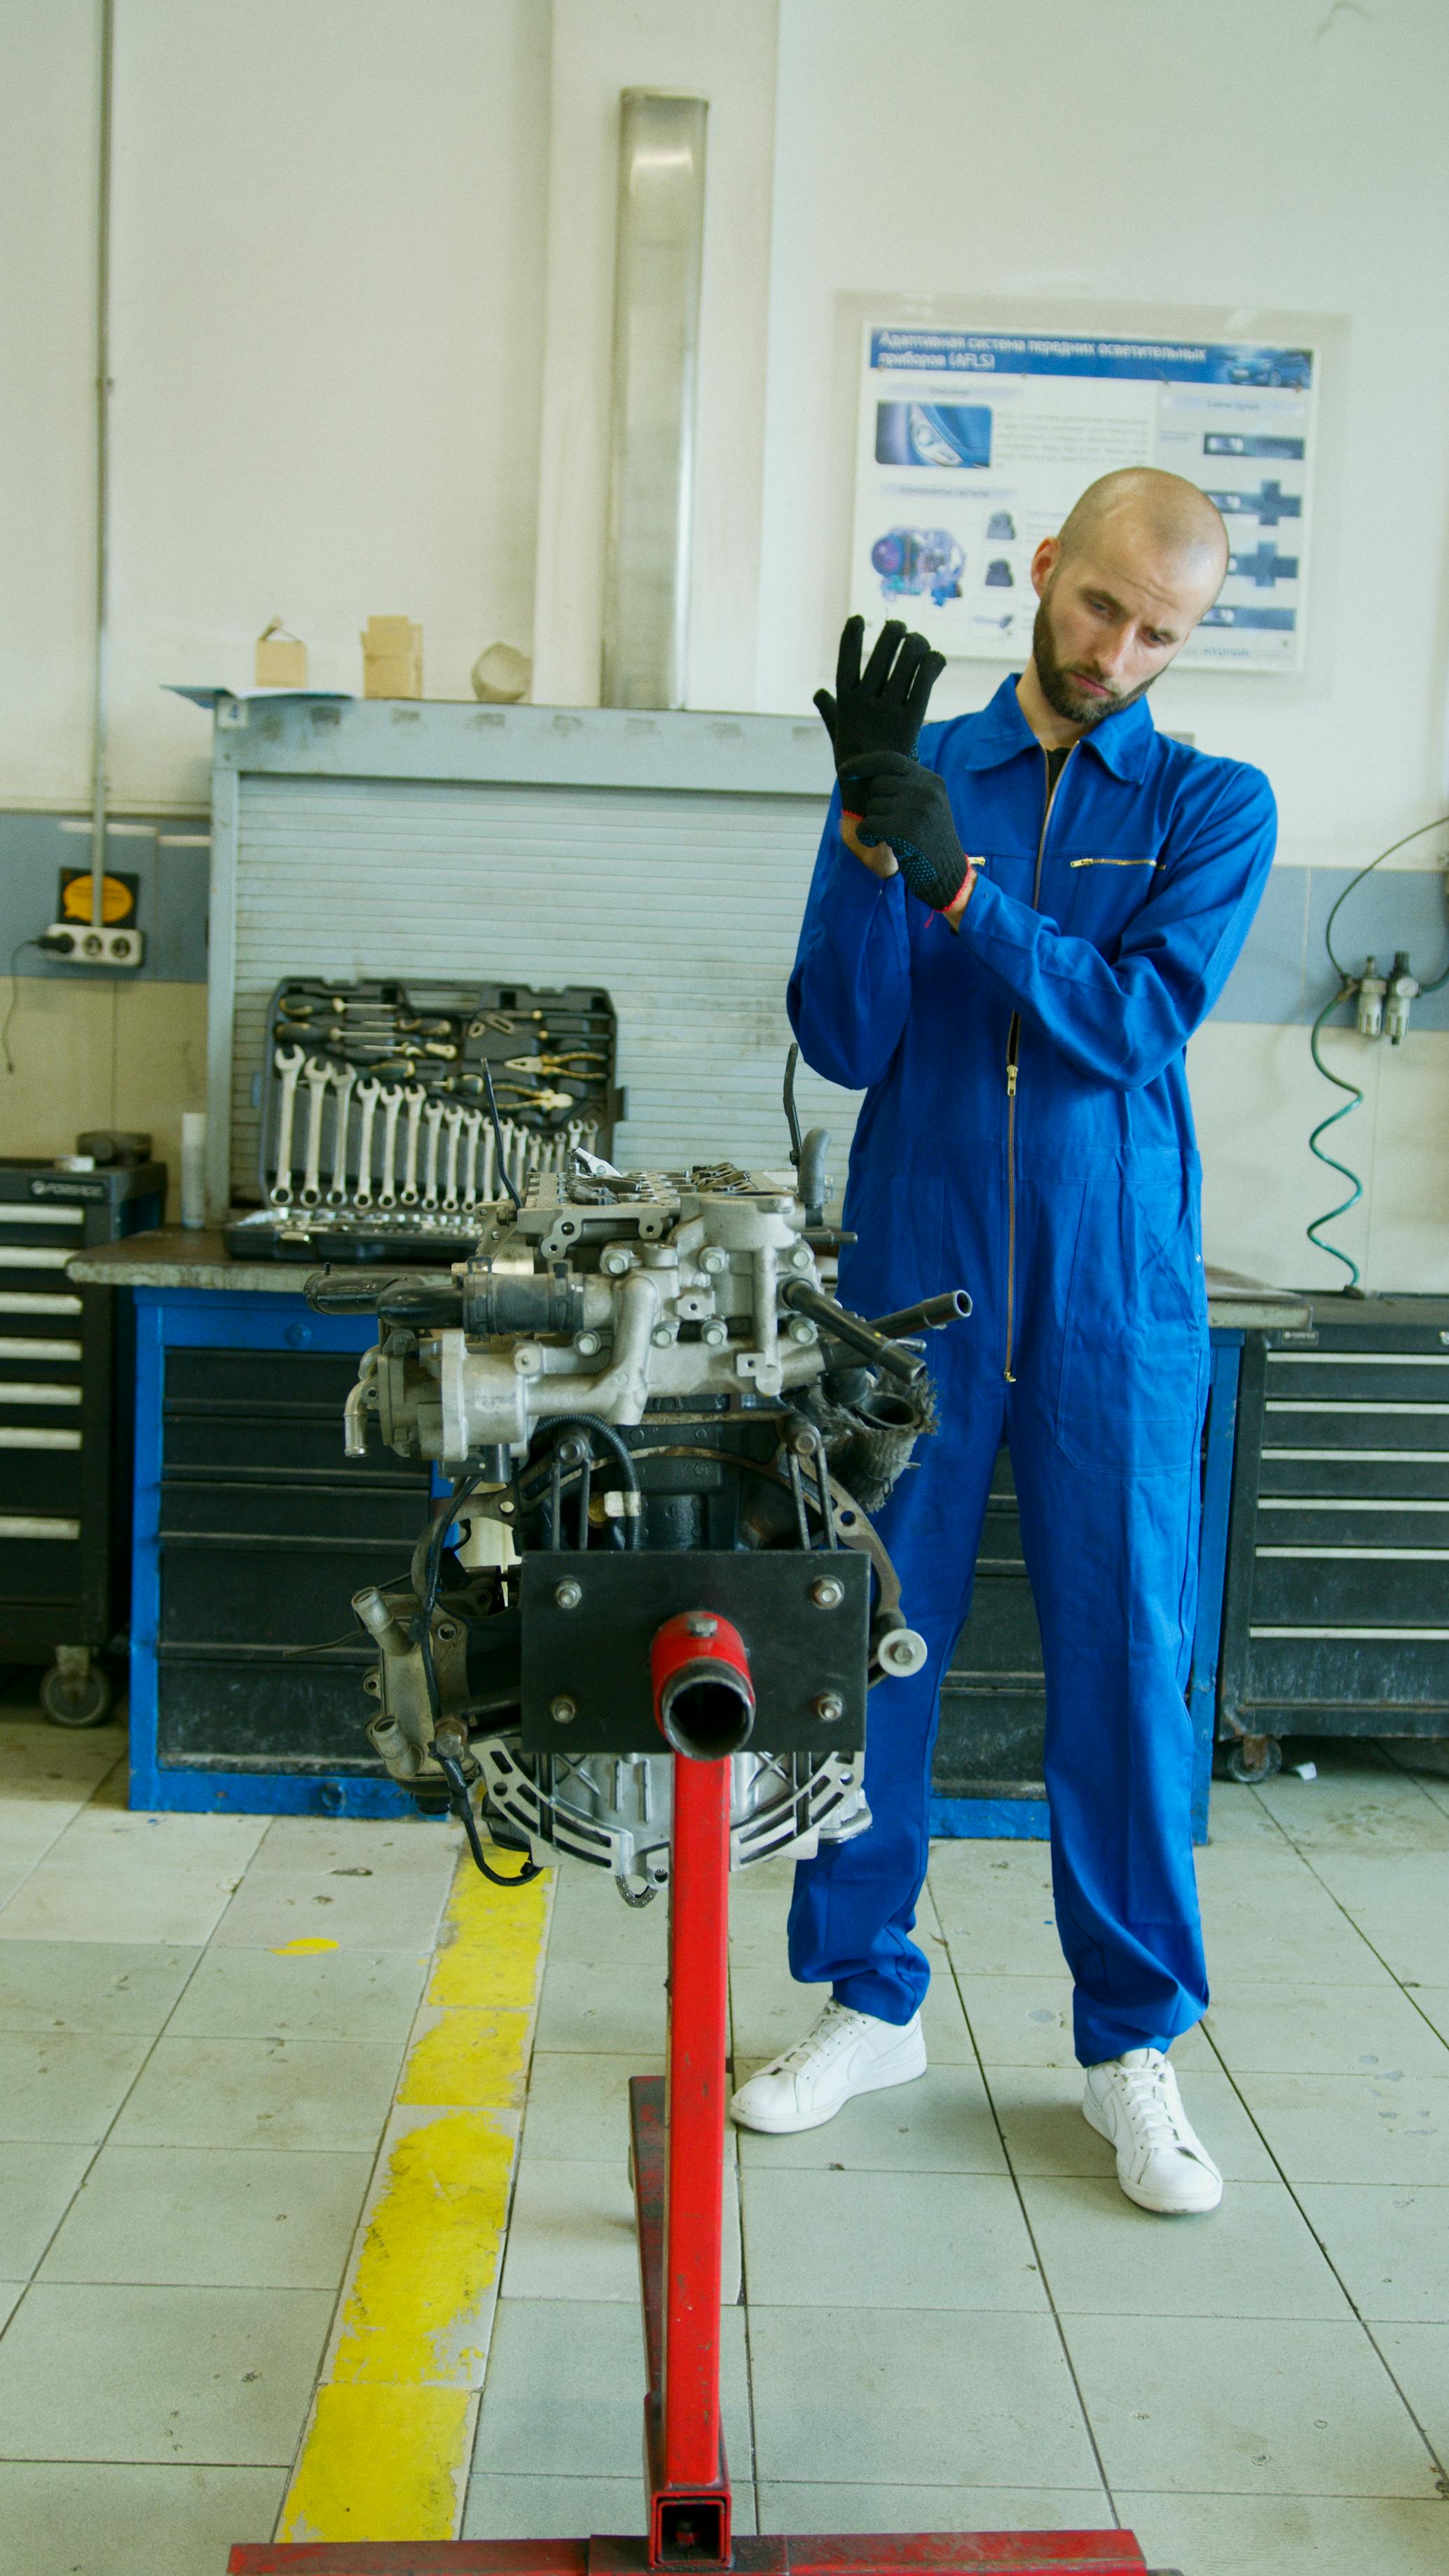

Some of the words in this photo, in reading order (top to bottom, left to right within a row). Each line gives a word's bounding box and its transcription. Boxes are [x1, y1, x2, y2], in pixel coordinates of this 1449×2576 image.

[878, 351, 945, 369] приборов
[967, 337, 1026, 351] система
[1027, 340, 1095, 357] передних
[1097, 343, 1206, 362] осветительных
